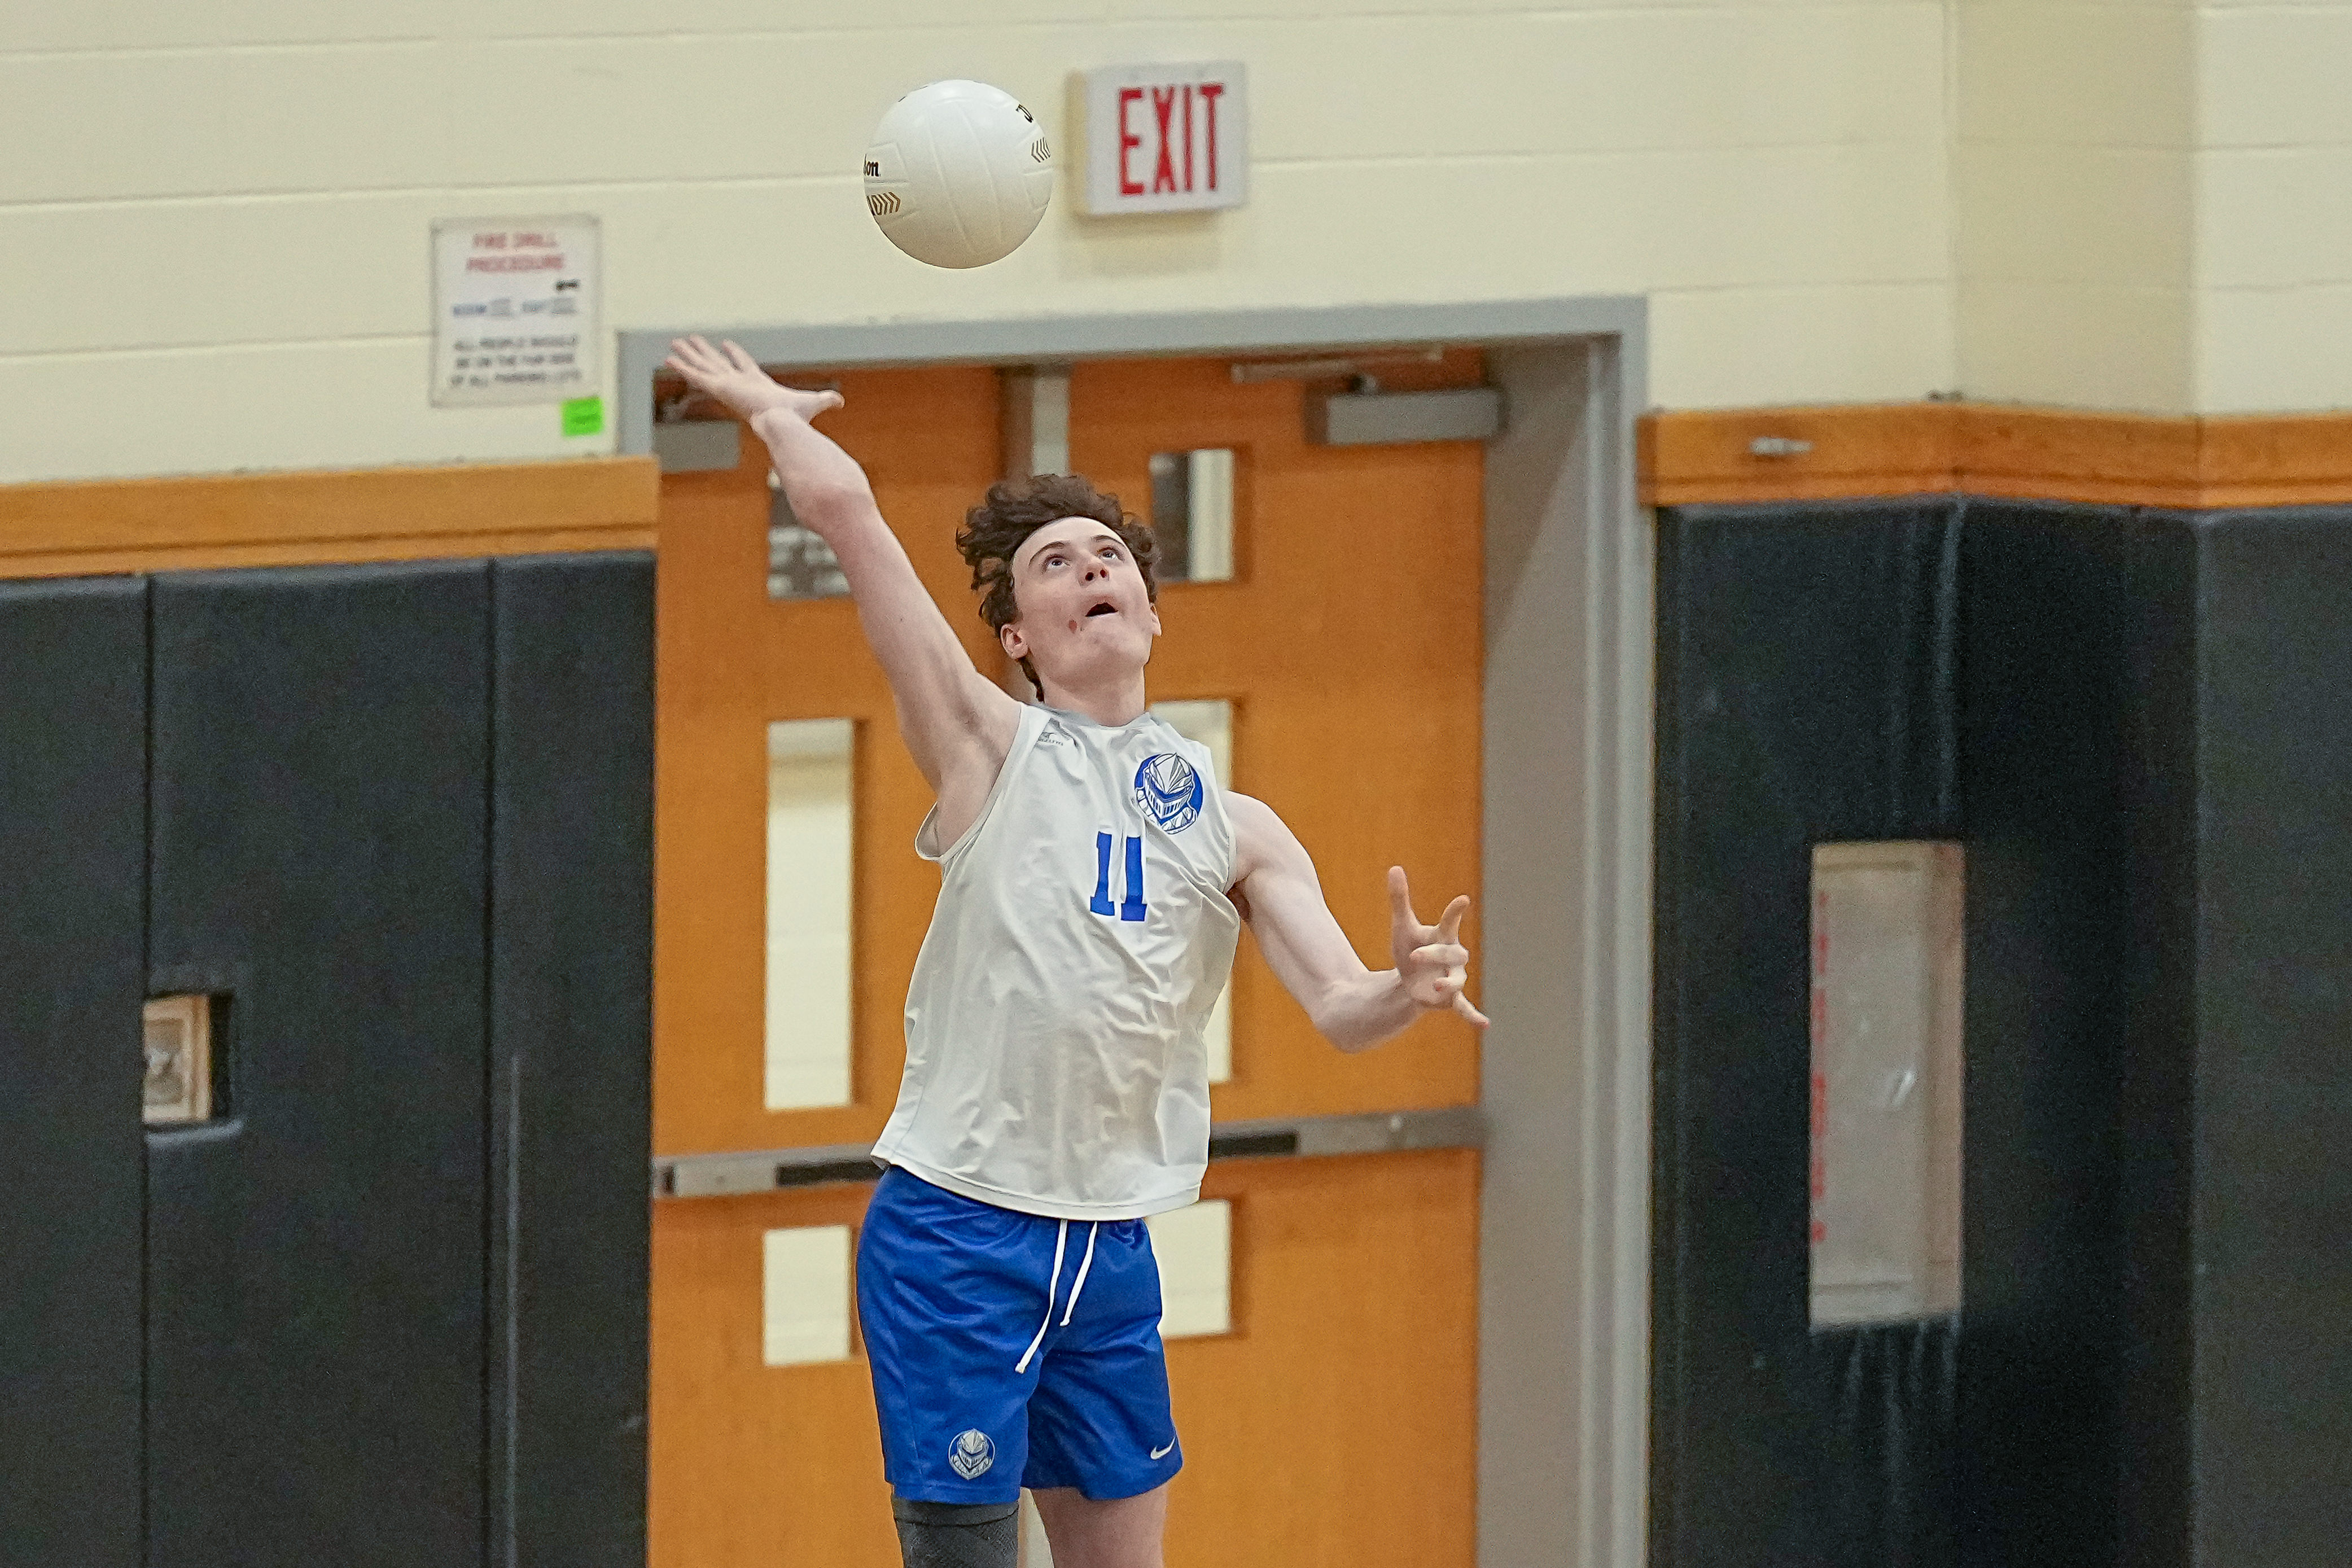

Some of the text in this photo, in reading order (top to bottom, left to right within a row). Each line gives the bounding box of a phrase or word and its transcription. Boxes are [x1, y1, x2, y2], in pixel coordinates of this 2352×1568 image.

[1119, 84, 1224, 195] EXIT
[466, 254, 564, 272] PROCEDURE
[473, 232, 558, 248] FIRE DRILL
[1090, 831, 1147, 922] 11
